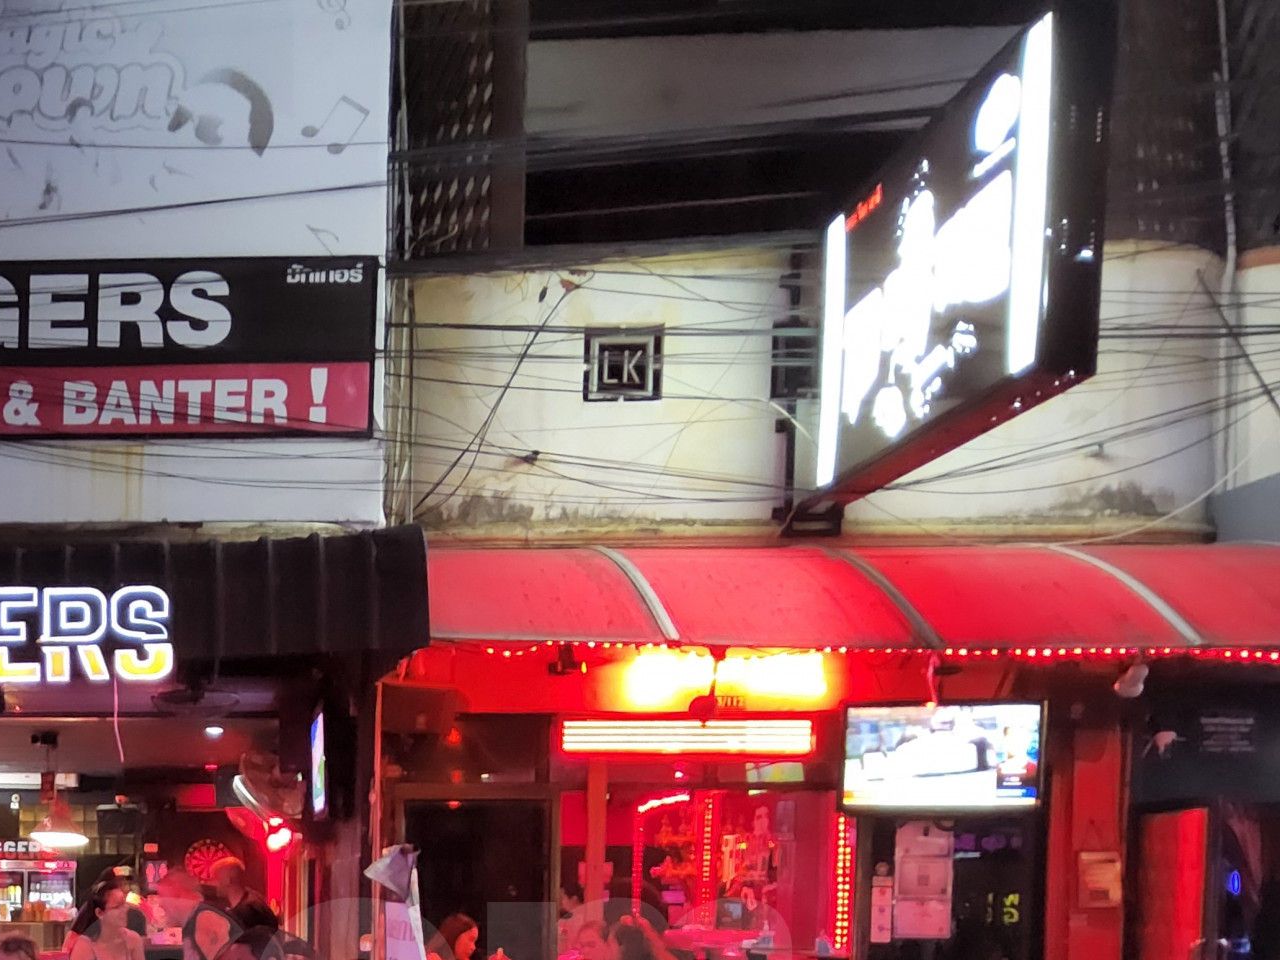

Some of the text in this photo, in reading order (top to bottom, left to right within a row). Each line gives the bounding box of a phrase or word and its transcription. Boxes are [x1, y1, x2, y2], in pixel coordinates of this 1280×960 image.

[603, 349, 643, 384] LK
[3, 380, 41, 428] &
[61, 378, 289, 428] BANTER
